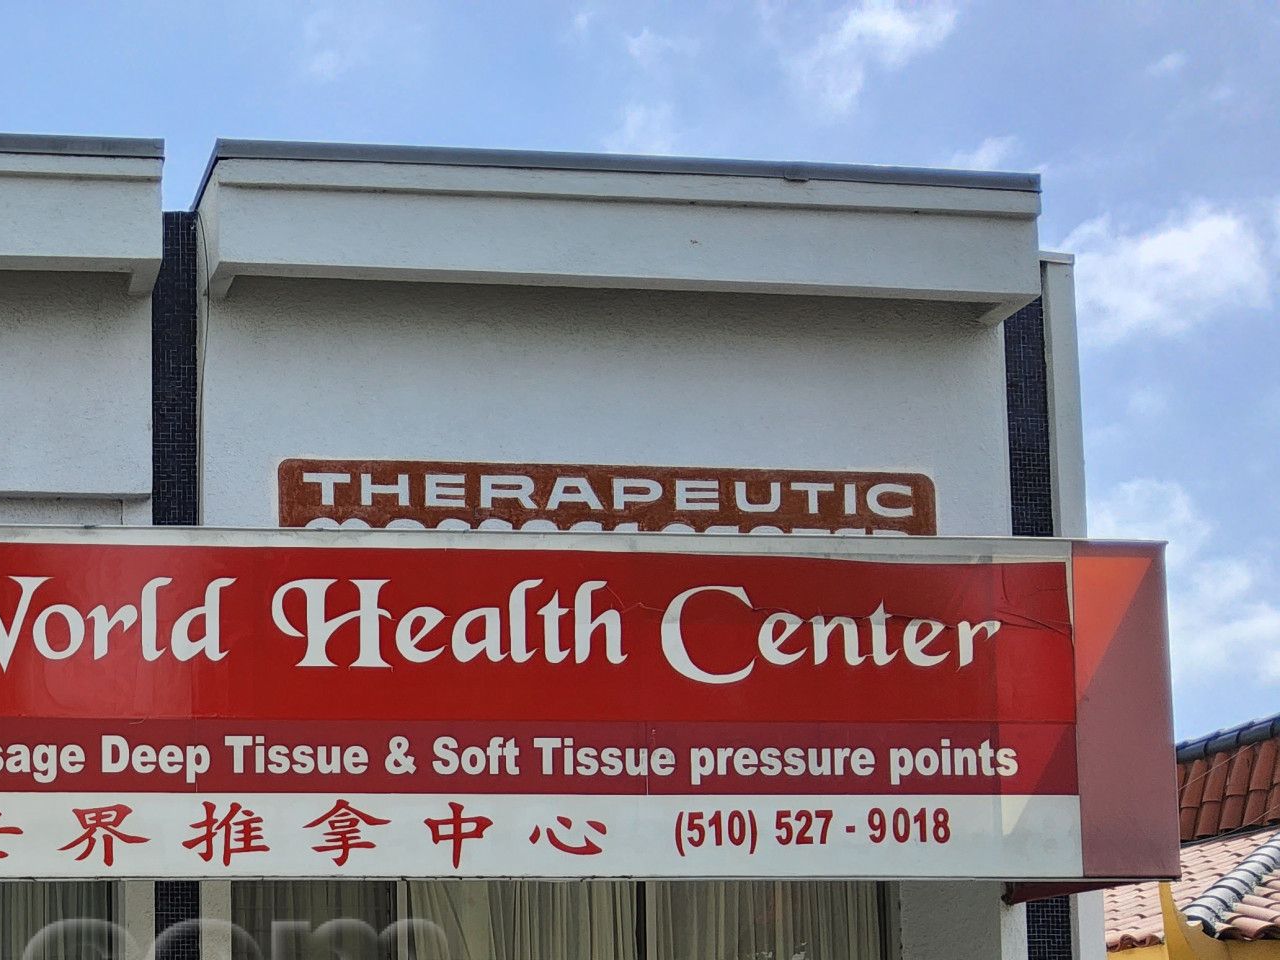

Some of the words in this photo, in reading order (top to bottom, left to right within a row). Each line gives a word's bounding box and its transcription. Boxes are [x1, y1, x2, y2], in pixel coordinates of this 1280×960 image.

[302, 471, 915, 519] THERAPEUTIC
[272, 576, 629, 670] Health
[660, 584, 1002, 685] Center
[101, 735, 211, 784] Deep
[224, 735, 370, 776] Tissue
[385, 736, 418, 776] &
[432, 736, 522, 777] Soft
[533, 737, 676, 778] Tissue
[690, 743, 877, 786] pressure
[890, 738, 1020, 786] points
[674, 809, 759, 857] (510)
